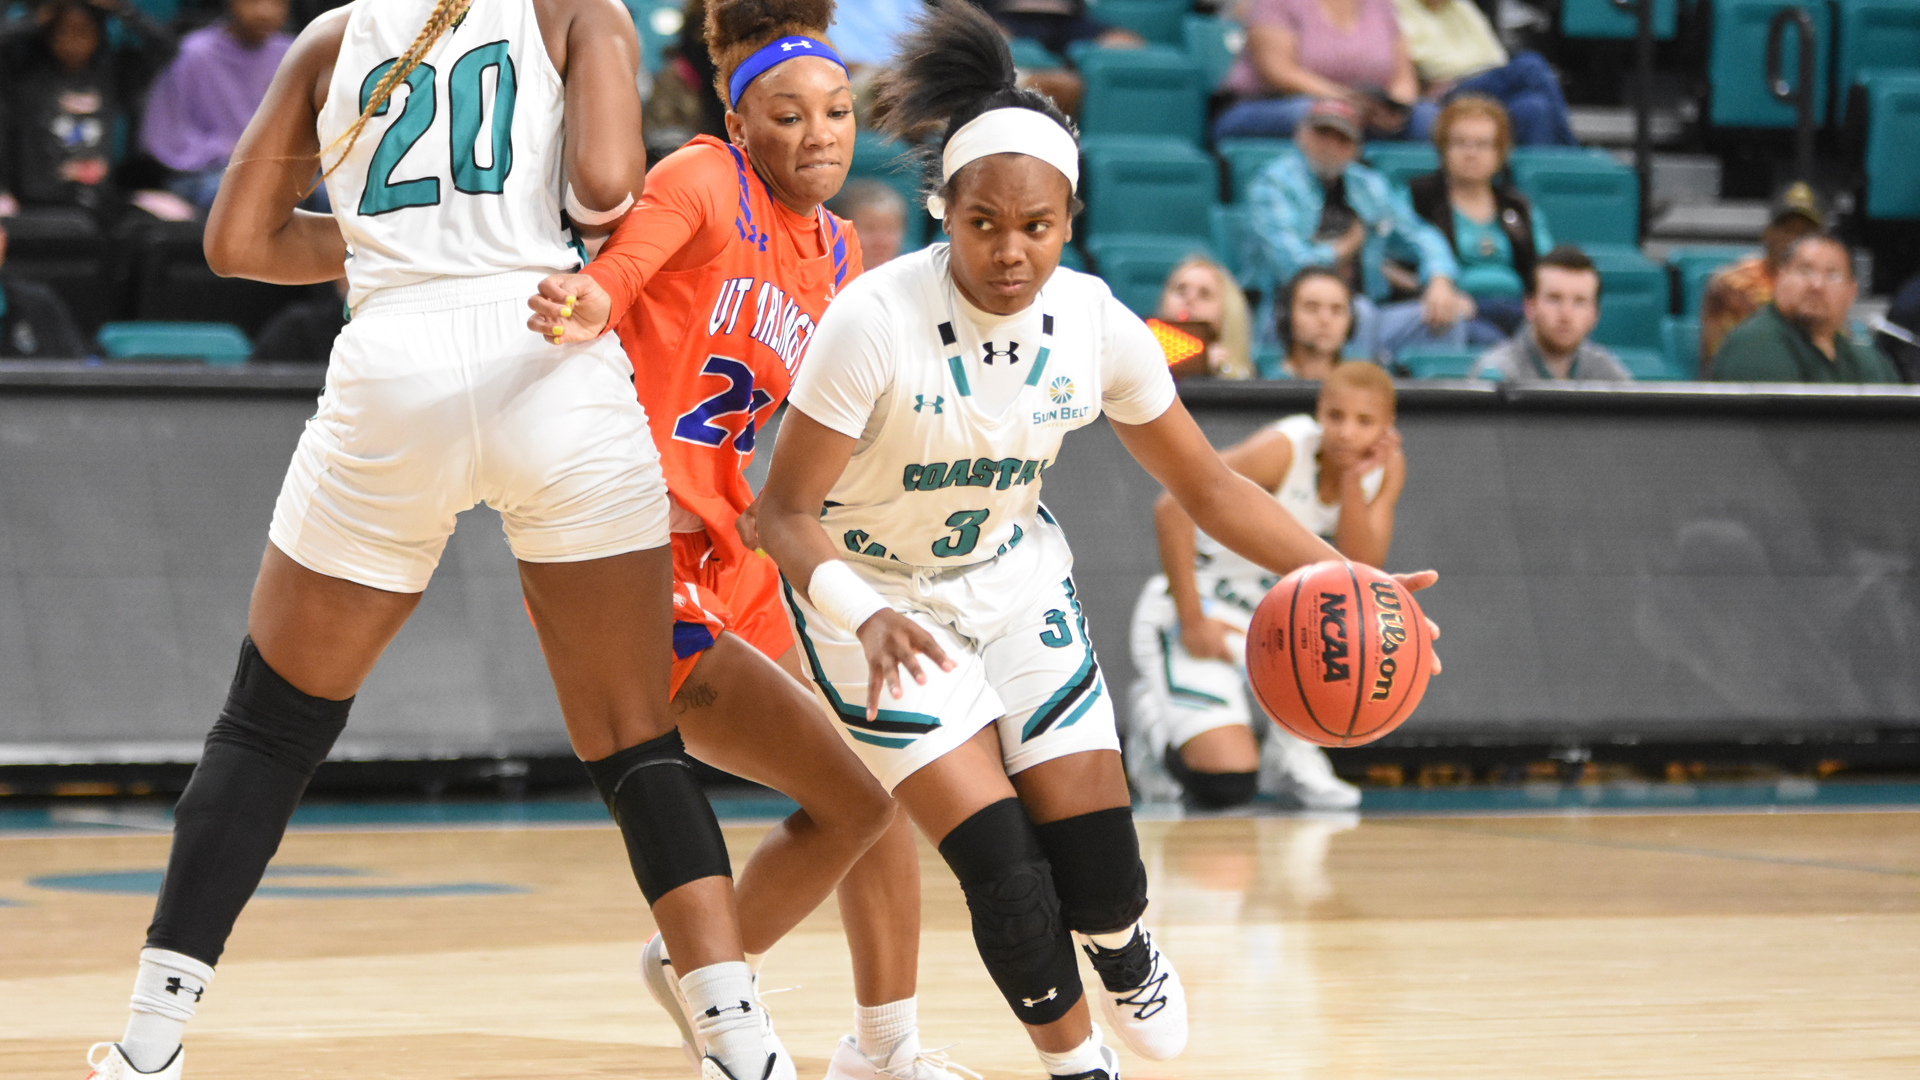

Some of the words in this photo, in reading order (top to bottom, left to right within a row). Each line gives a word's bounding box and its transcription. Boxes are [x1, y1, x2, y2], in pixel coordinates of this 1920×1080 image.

[357, 39, 518, 216] 20
[708, 277, 755, 337] UT
[748, 280, 817, 386] ARLINGT
[1060, 405, 1089, 420] BELT
[931, 508, 990, 558] 3
[1039, 608, 1073, 648] 3
[1320, 592, 1350, 683] NCAA
[1369, 581, 1408, 703] Wilson
